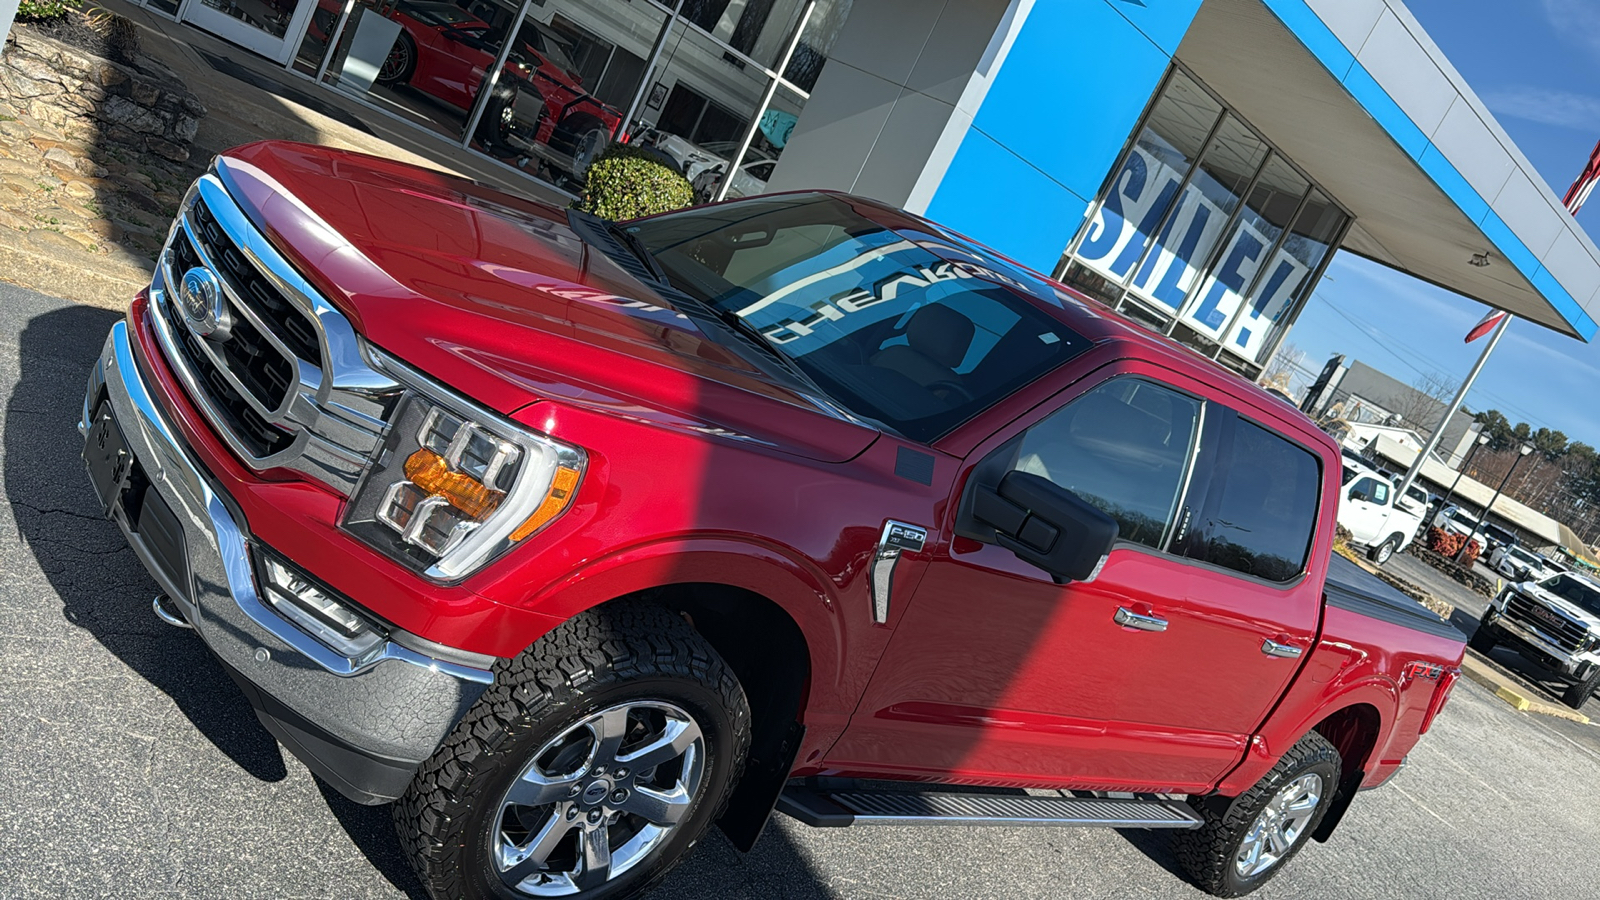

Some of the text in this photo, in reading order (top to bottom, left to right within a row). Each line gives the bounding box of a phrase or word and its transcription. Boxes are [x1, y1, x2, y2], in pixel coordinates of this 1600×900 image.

[1076, 150, 1295, 349] SALE!
[891, 526, 924, 542] F-150
[1407, 660, 1443, 680] FX4
